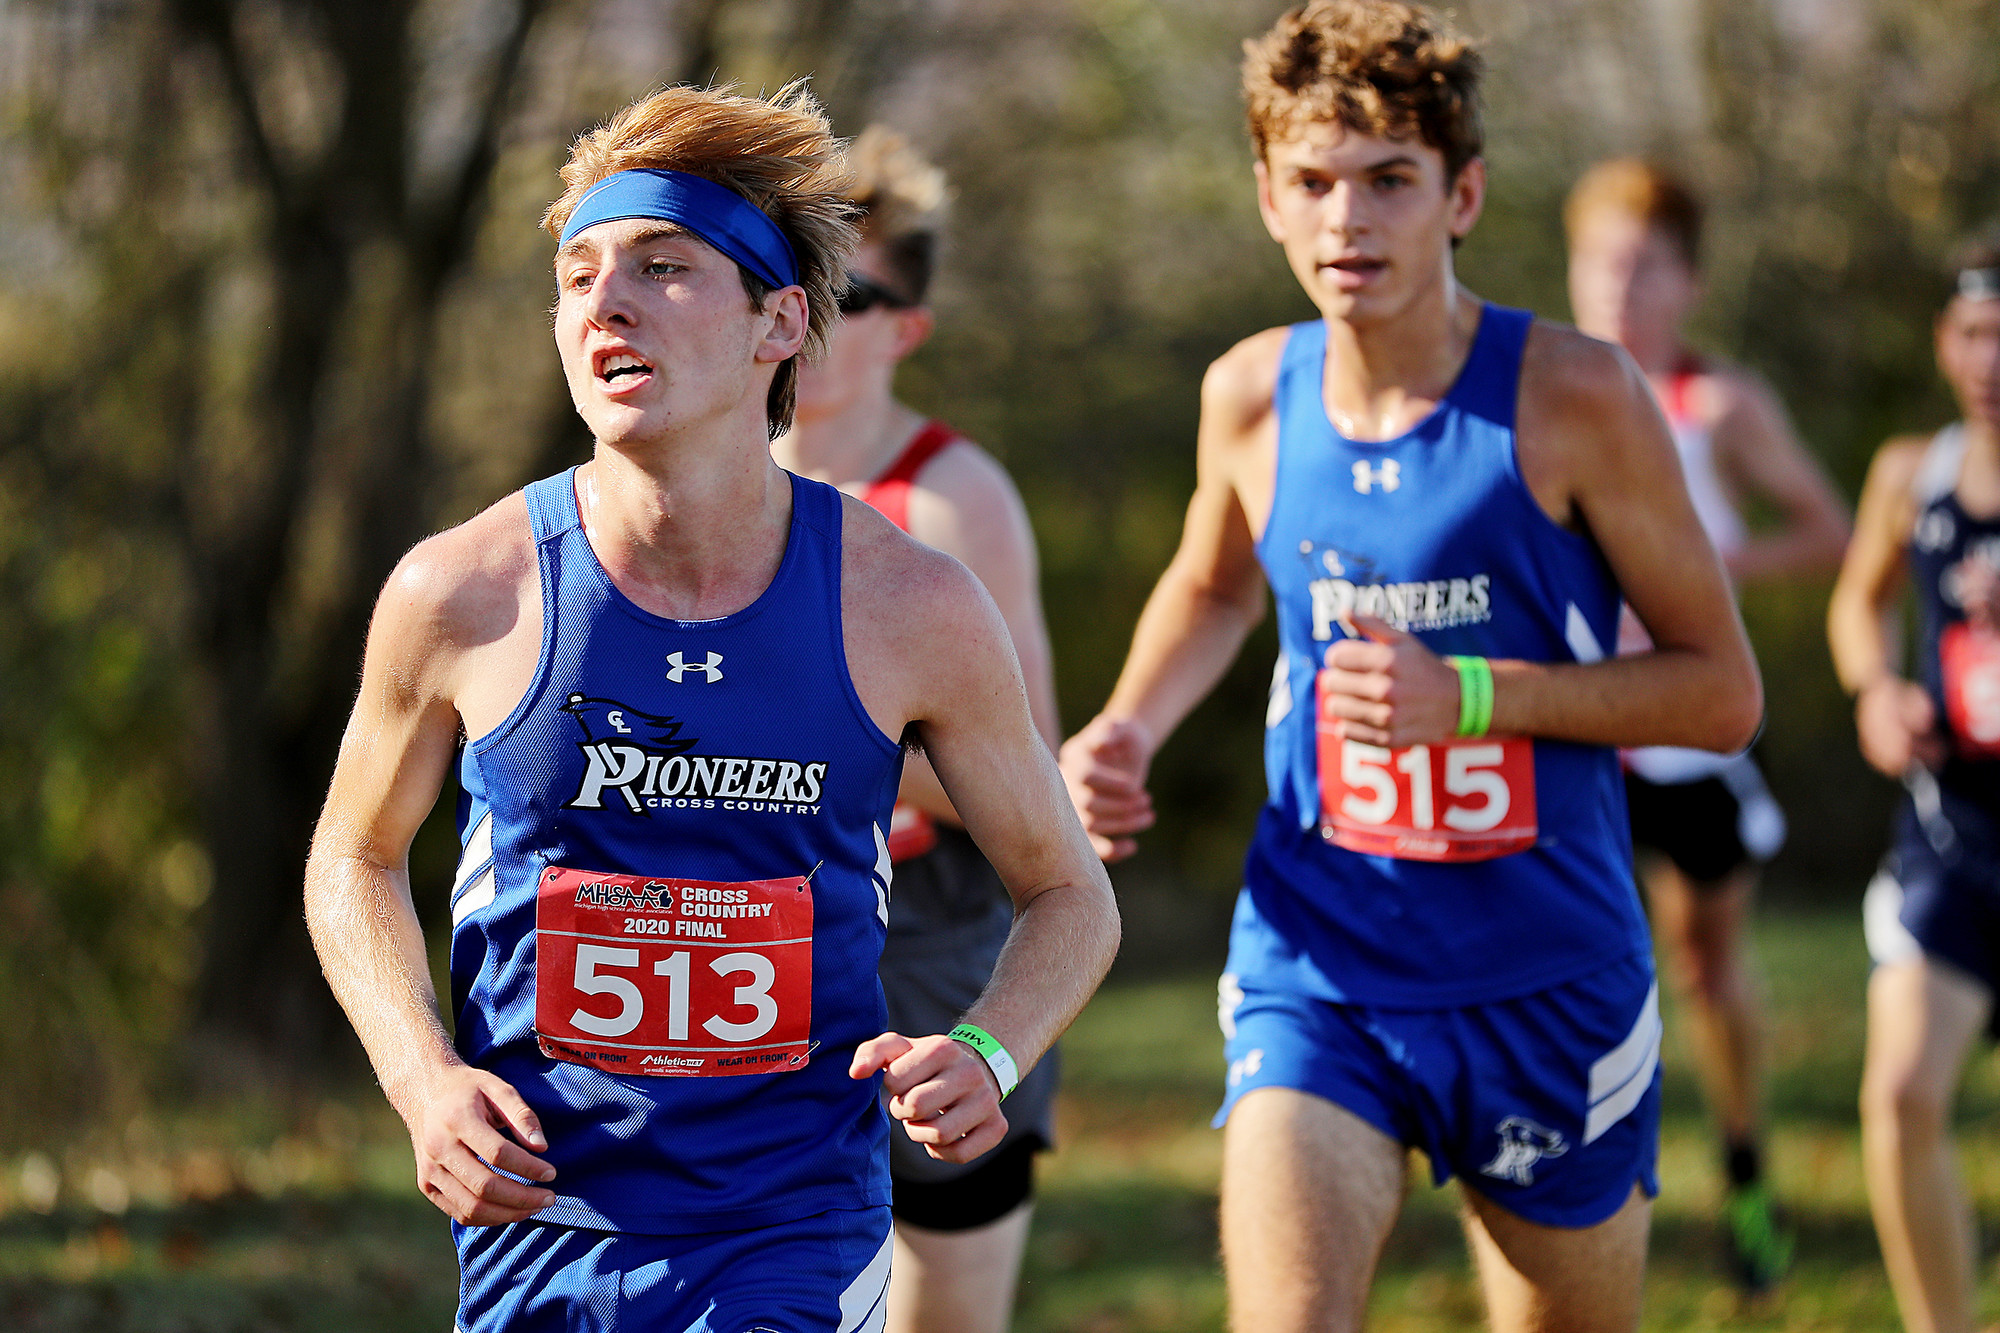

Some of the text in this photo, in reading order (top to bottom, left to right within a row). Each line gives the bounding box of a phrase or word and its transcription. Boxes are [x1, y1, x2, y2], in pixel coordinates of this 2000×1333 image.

[1309, 573, 1490, 641] PIONEERS
[570, 742, 826, 813] PIONEERS
[1340, 739, 1511, 832] 515
[646, 798, 822, 815] CROSS COUNTRY
[575, 880, 660, 909] MHSAA
[681, 886, 749, 904] CROSS
[680, 902, 774, 919] COUNTRY
[623, 917, 727, 939] 2020 FINAL
[569, 943, 778, 1042] 513
[584, 1051, 597, 1060] ON
[600, 1052, 628, 1063] FRONT
[717, 1052, 789, 1067] WEAR ON FRONT
